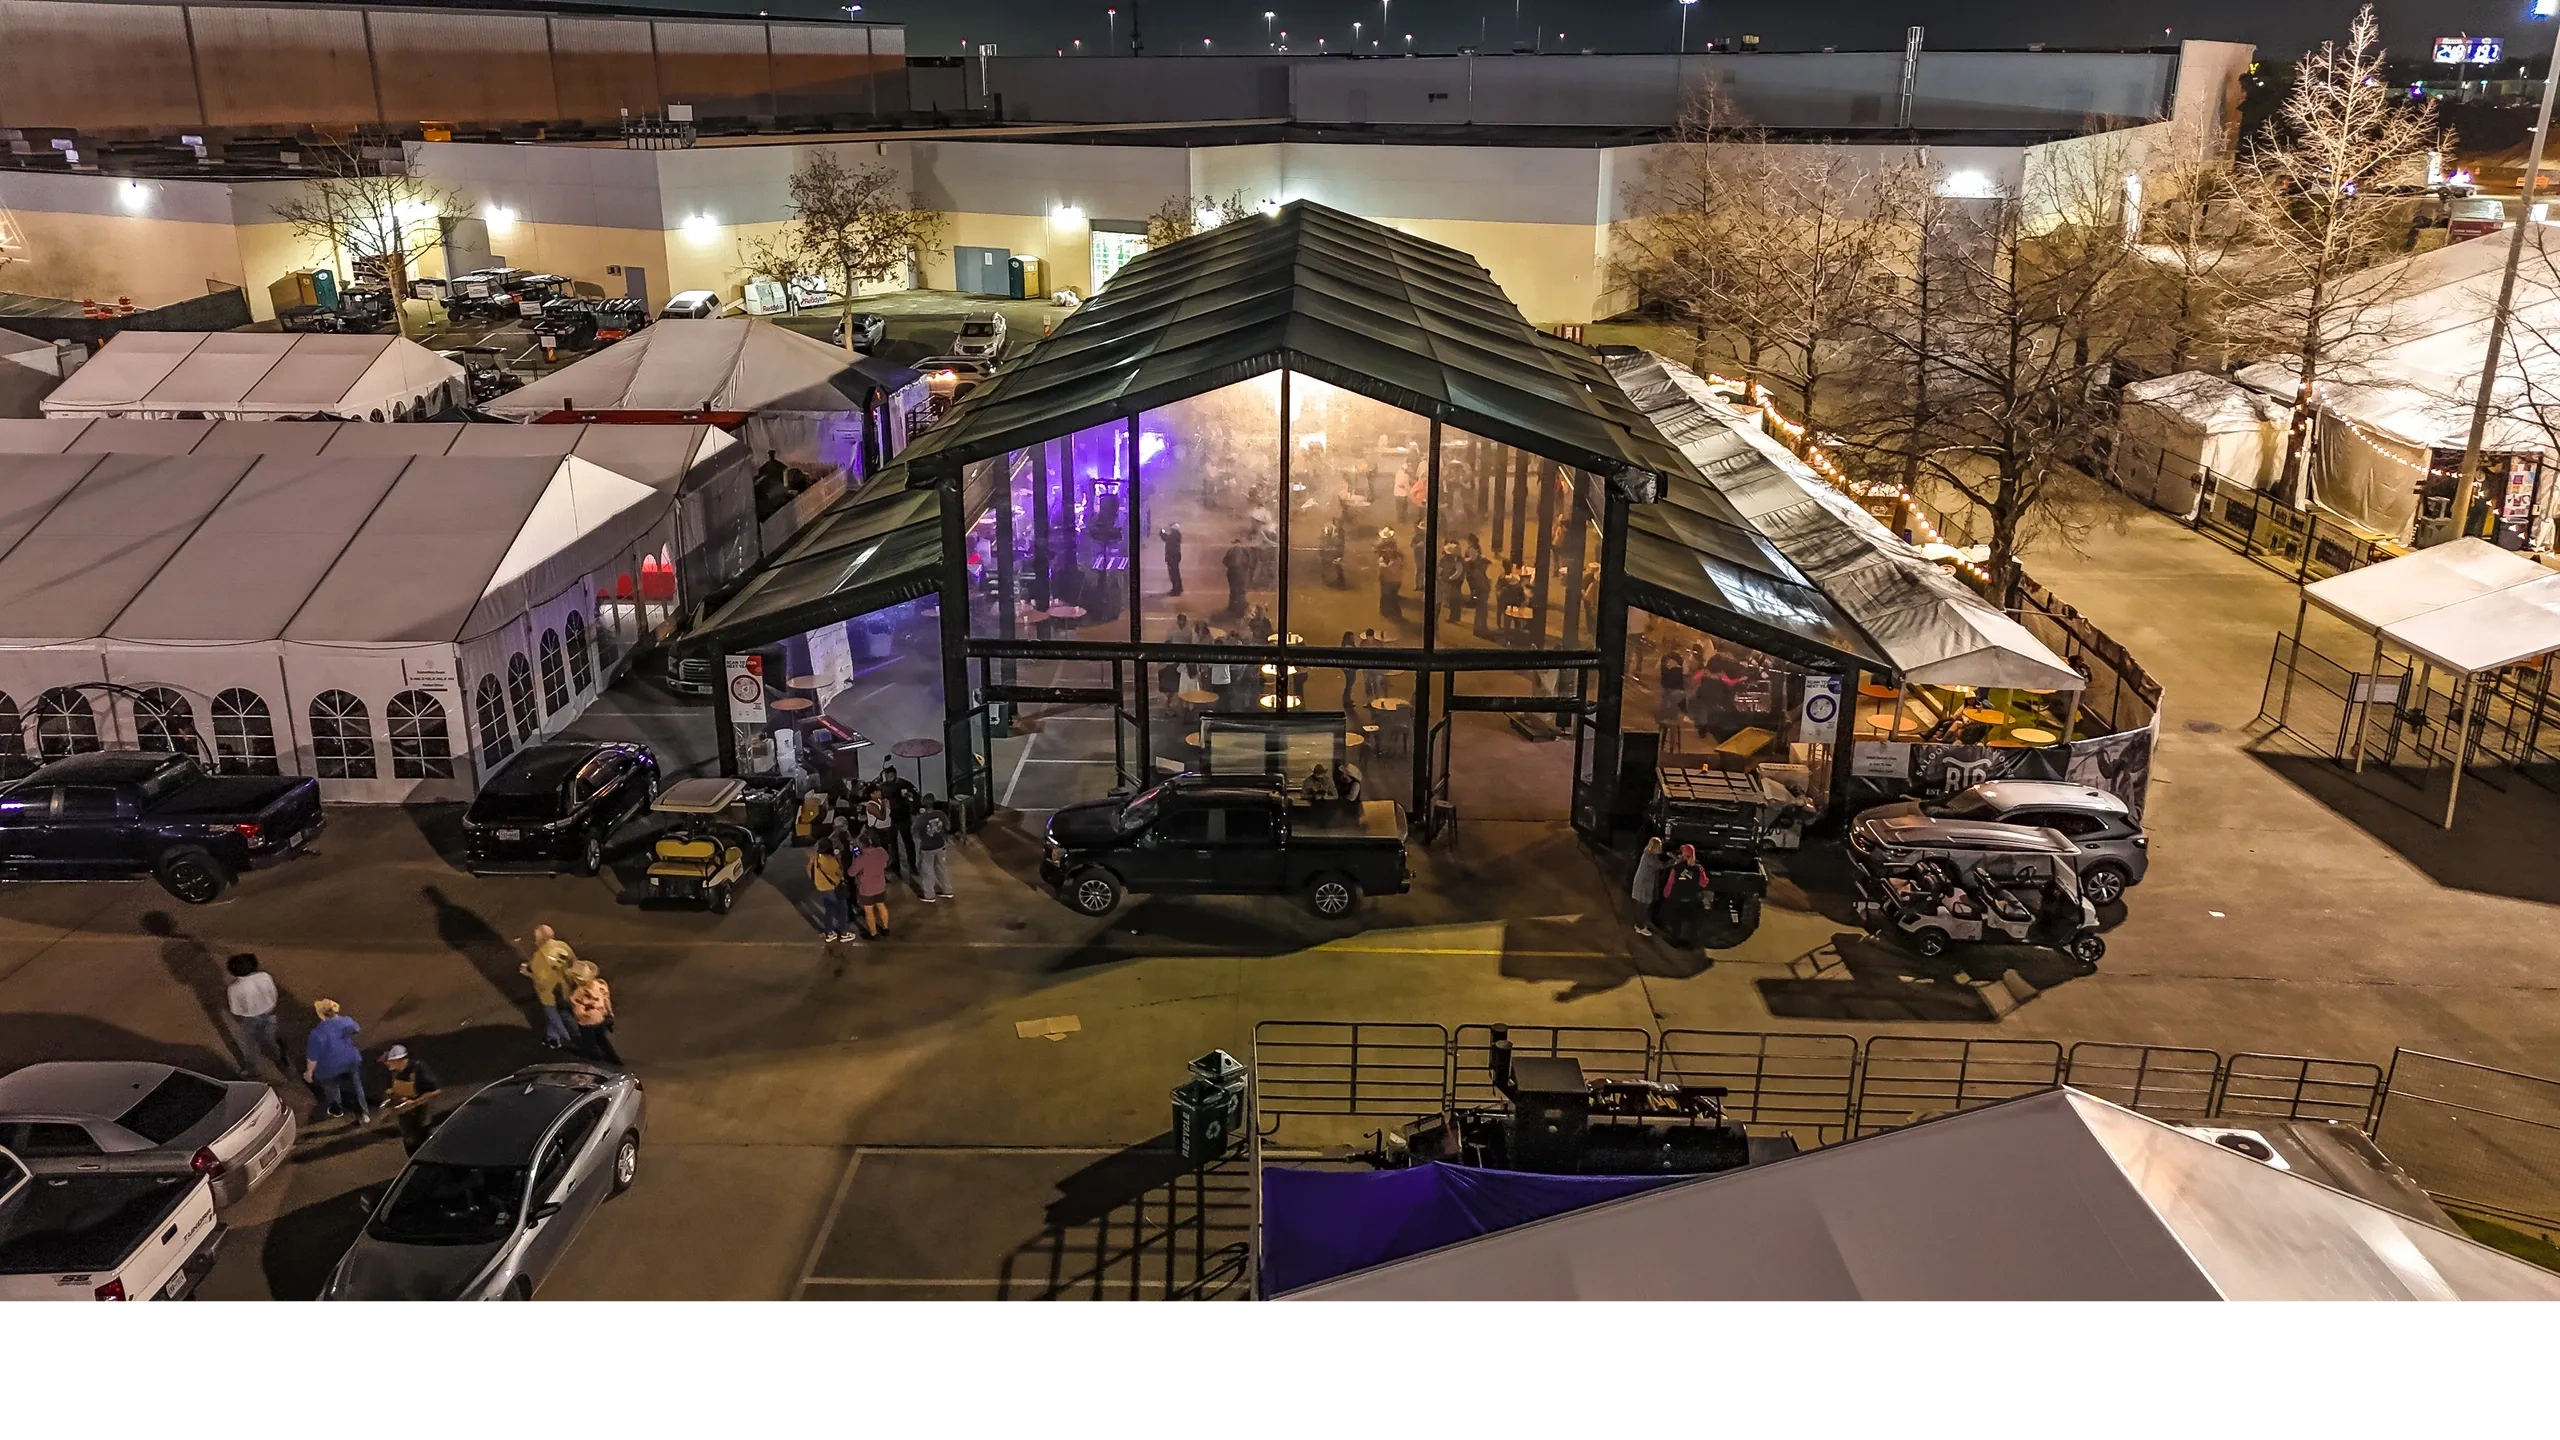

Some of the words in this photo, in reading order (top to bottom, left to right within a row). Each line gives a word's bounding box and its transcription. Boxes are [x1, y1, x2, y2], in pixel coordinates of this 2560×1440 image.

[1915, 744, 1950, 777] SALOON
[1182, 1111, 1190, 1158] RECYCLE
[183, 1207, 212, 1241] TUNDRA
